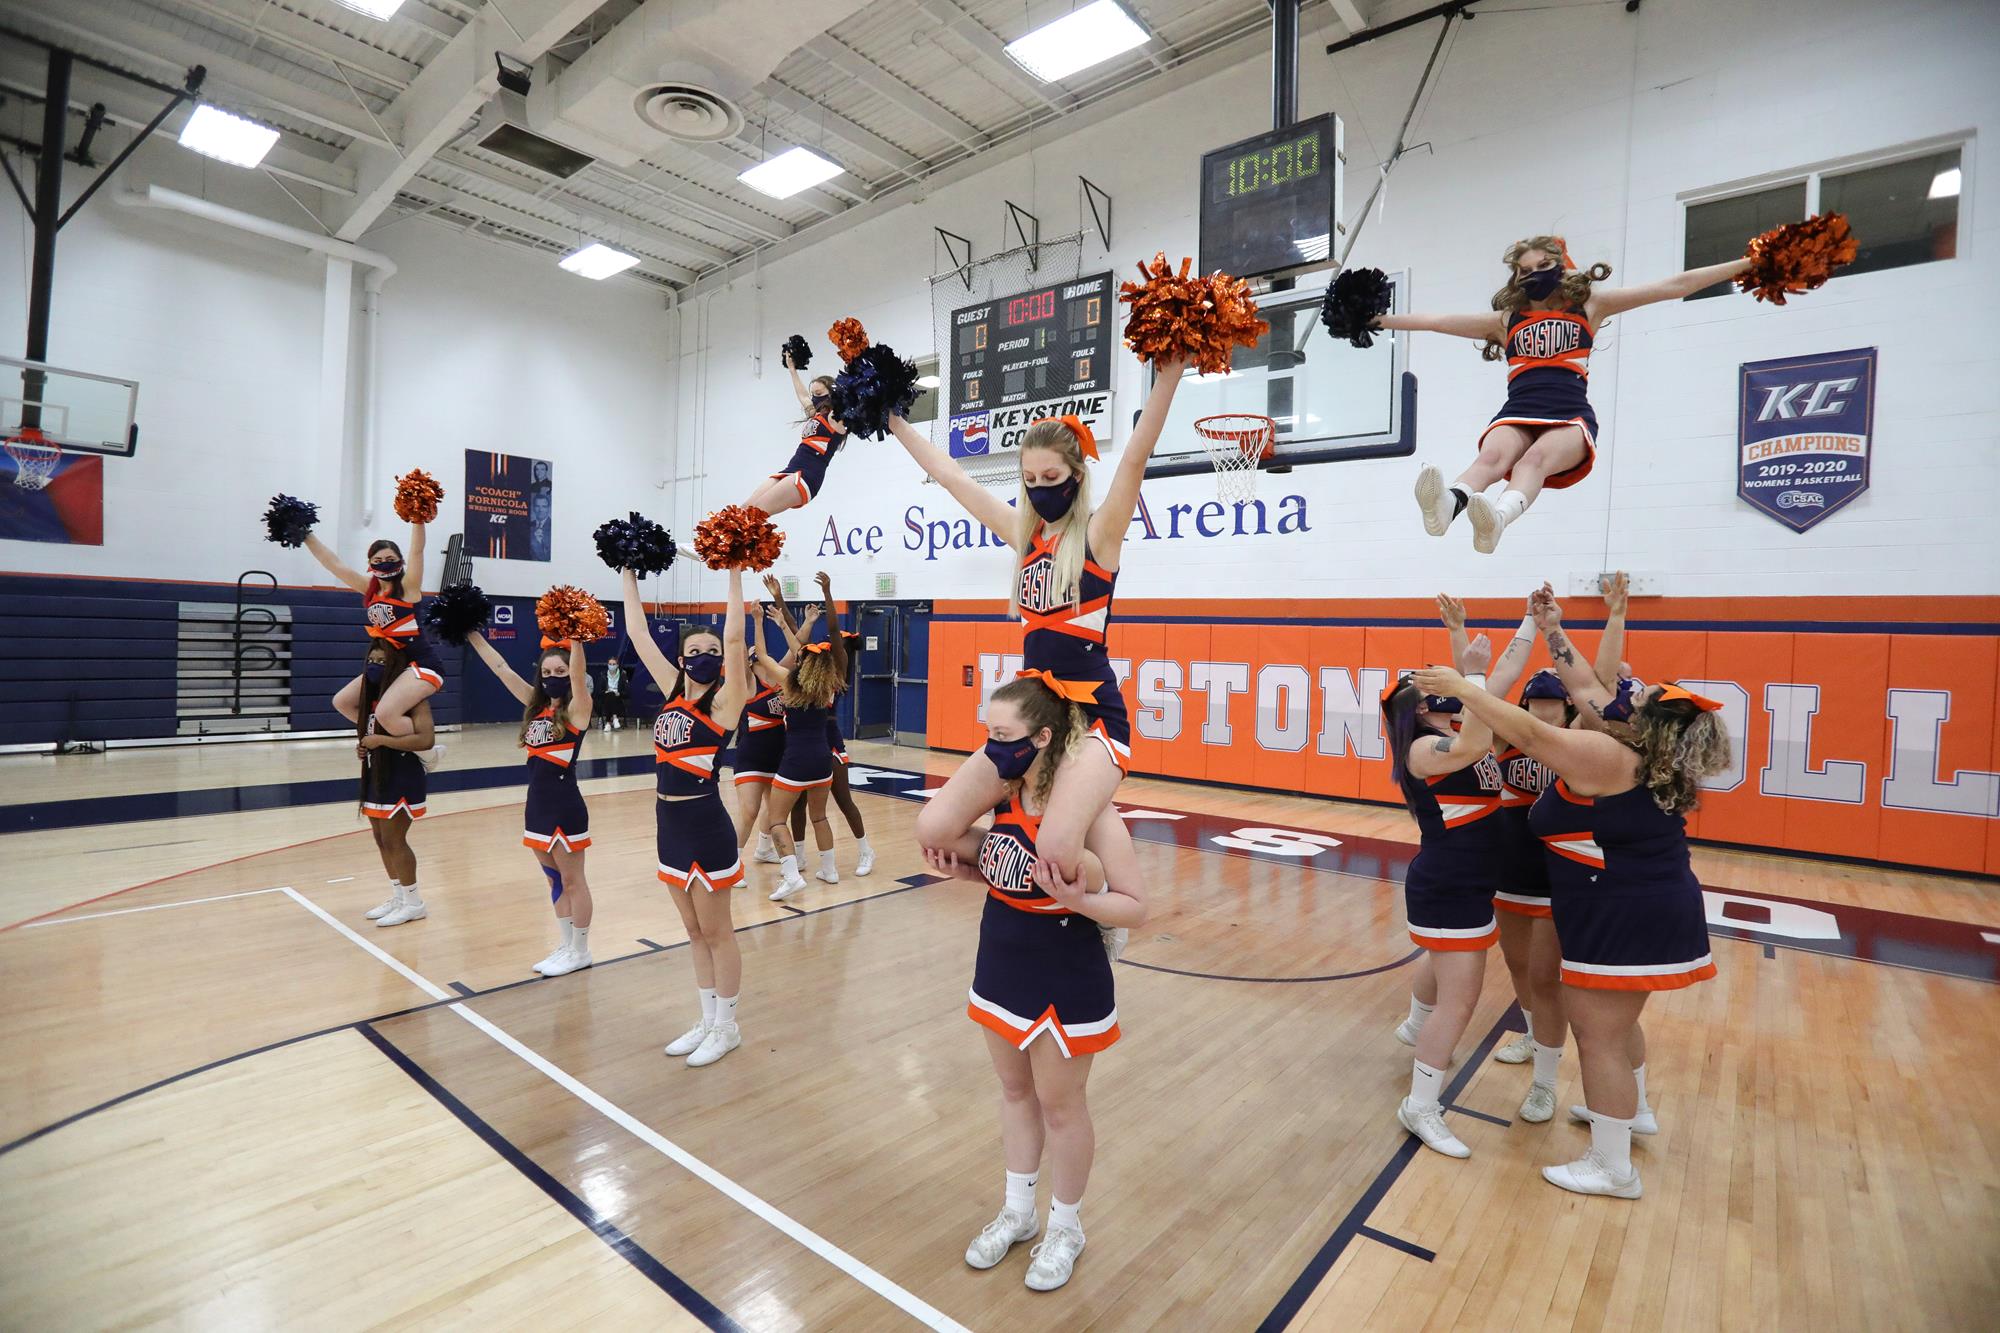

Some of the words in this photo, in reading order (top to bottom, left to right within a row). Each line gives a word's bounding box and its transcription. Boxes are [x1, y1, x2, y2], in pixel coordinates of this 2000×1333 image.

[1227, 134, 1319, 196] 10:00
[1065, 280, 1103, 299] HOME
[957, 307, 991, 325] GUEST
[1008, 290, 1055, 326] 10:00
[1087, 298, 1100, 325] 0
[976, 324, 987, 350] 0
[998, 337, 1029, 352] PERIOD
[1515, 319, 1581, 358] KEYSTONE
[1072, 347, 1095, 358] FOULS
[1002, 357, 1049, 372] PLAYER-FOUL
[963, 369, 983, 380] FOULS
[1069, 380, 1096, 392] POINTS
[961, 400, 984, 410] POINTS
[1002, 393, 1027, 403] MATCH
[1755, 377, 1858, 421] KC
[992, 396, 1107, 429] KEYSTONE
[950, 414, 989, 431] PEPSI
[1749, 435, 1860, 460] CHAMPIONS
[1759, 460, 1847, 477] 2019-2020
[1744, 479, 1790, 488] WOMENS
[1795, 474, 1862, 485] BASKETBALL
[468, 494, 528, 509] FORNICOLA
[1792, 494, 1822, 503] CSAC
[468, 504, 507, 514] WRESTLING
[489, 514, 507, 523] KC
[816, 514, 883, 557] Ace
[903, 498, 1016, 561] Spal
[1123, 491, 1312, 541] Arena
[1018, 557, 1076, 612] EYST
[977, 653, 1412, 761] KSTON
[654, 711, 694, 748] EYSTONE
